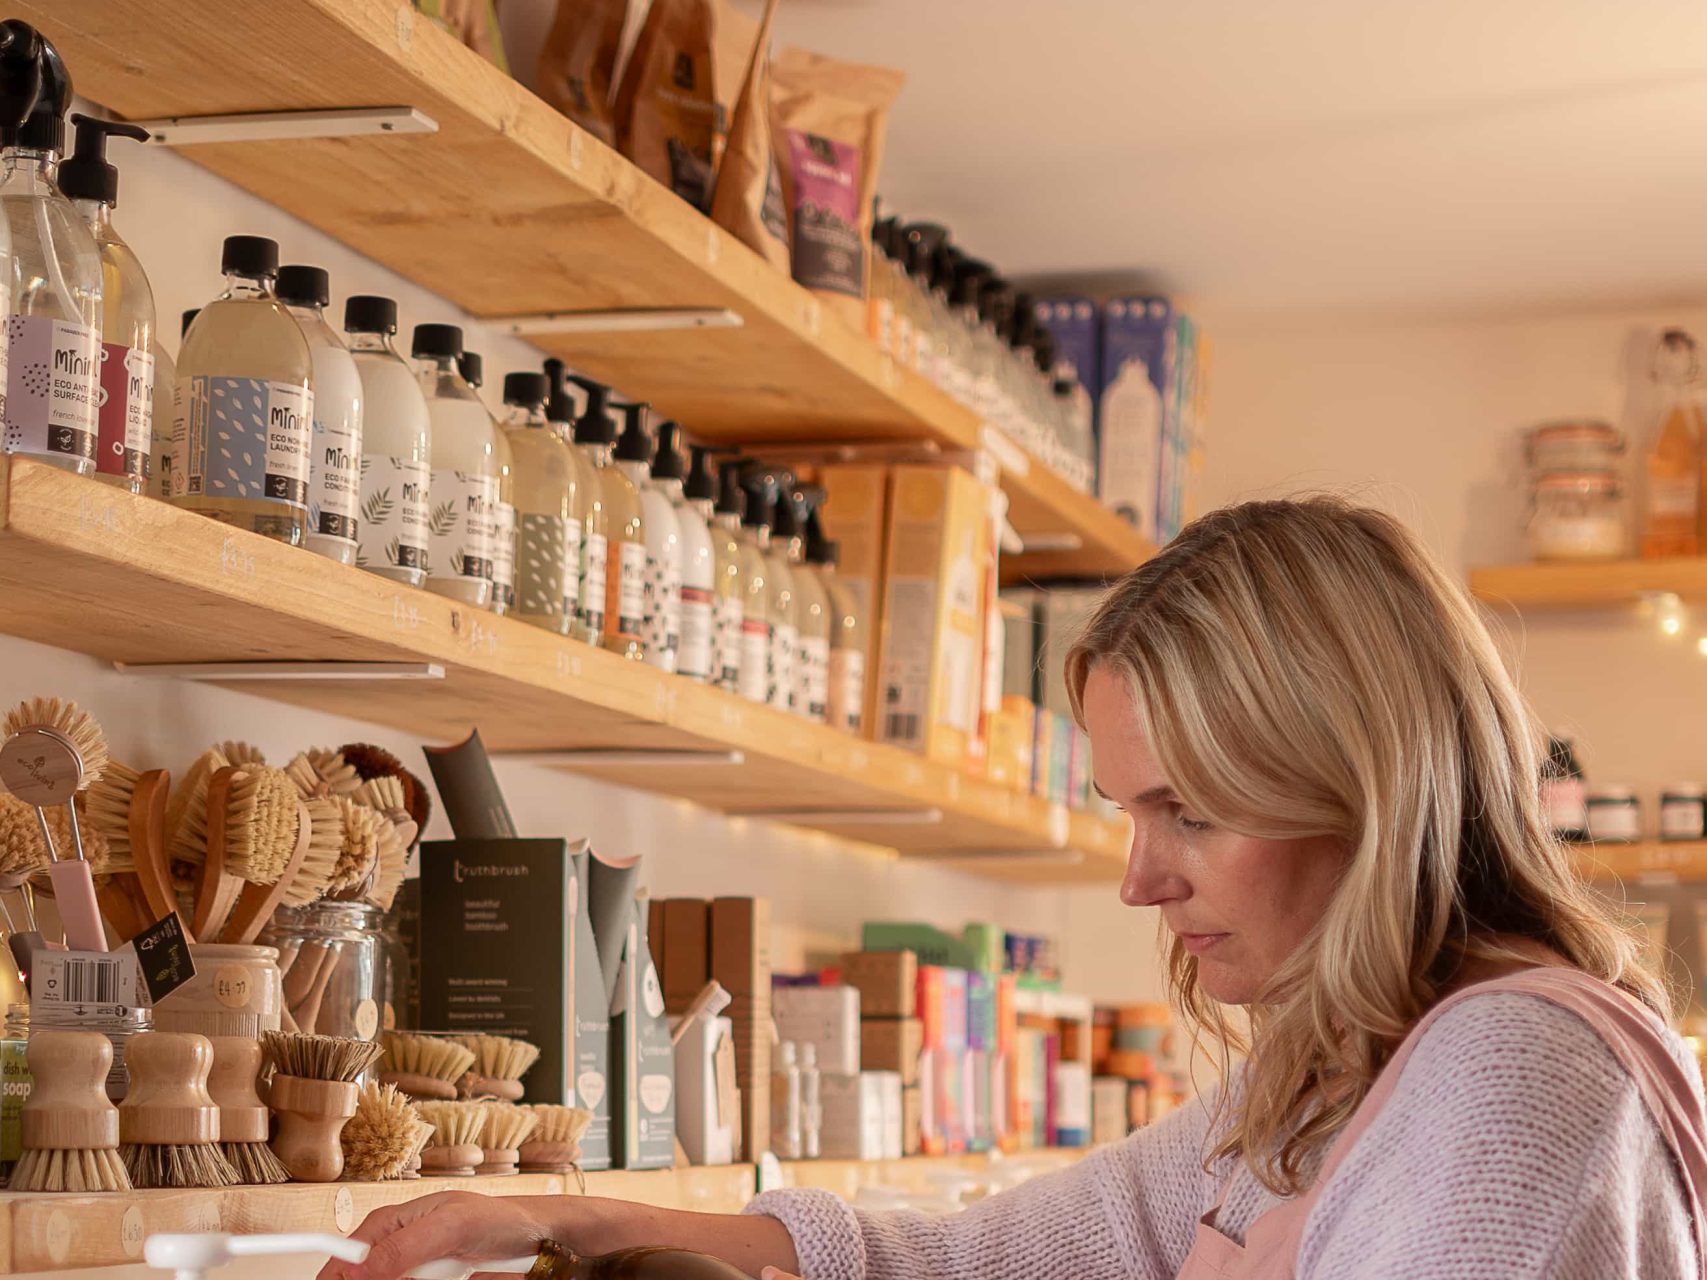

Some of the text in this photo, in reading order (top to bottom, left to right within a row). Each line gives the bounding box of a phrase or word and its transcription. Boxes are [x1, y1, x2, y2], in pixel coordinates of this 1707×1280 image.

[54, 380, 72, 390] ECO
[271, 434, 286, 443] ECO
[4, 1061, 19, 1075] dish
[3, 1081, 31, 1101] soap
